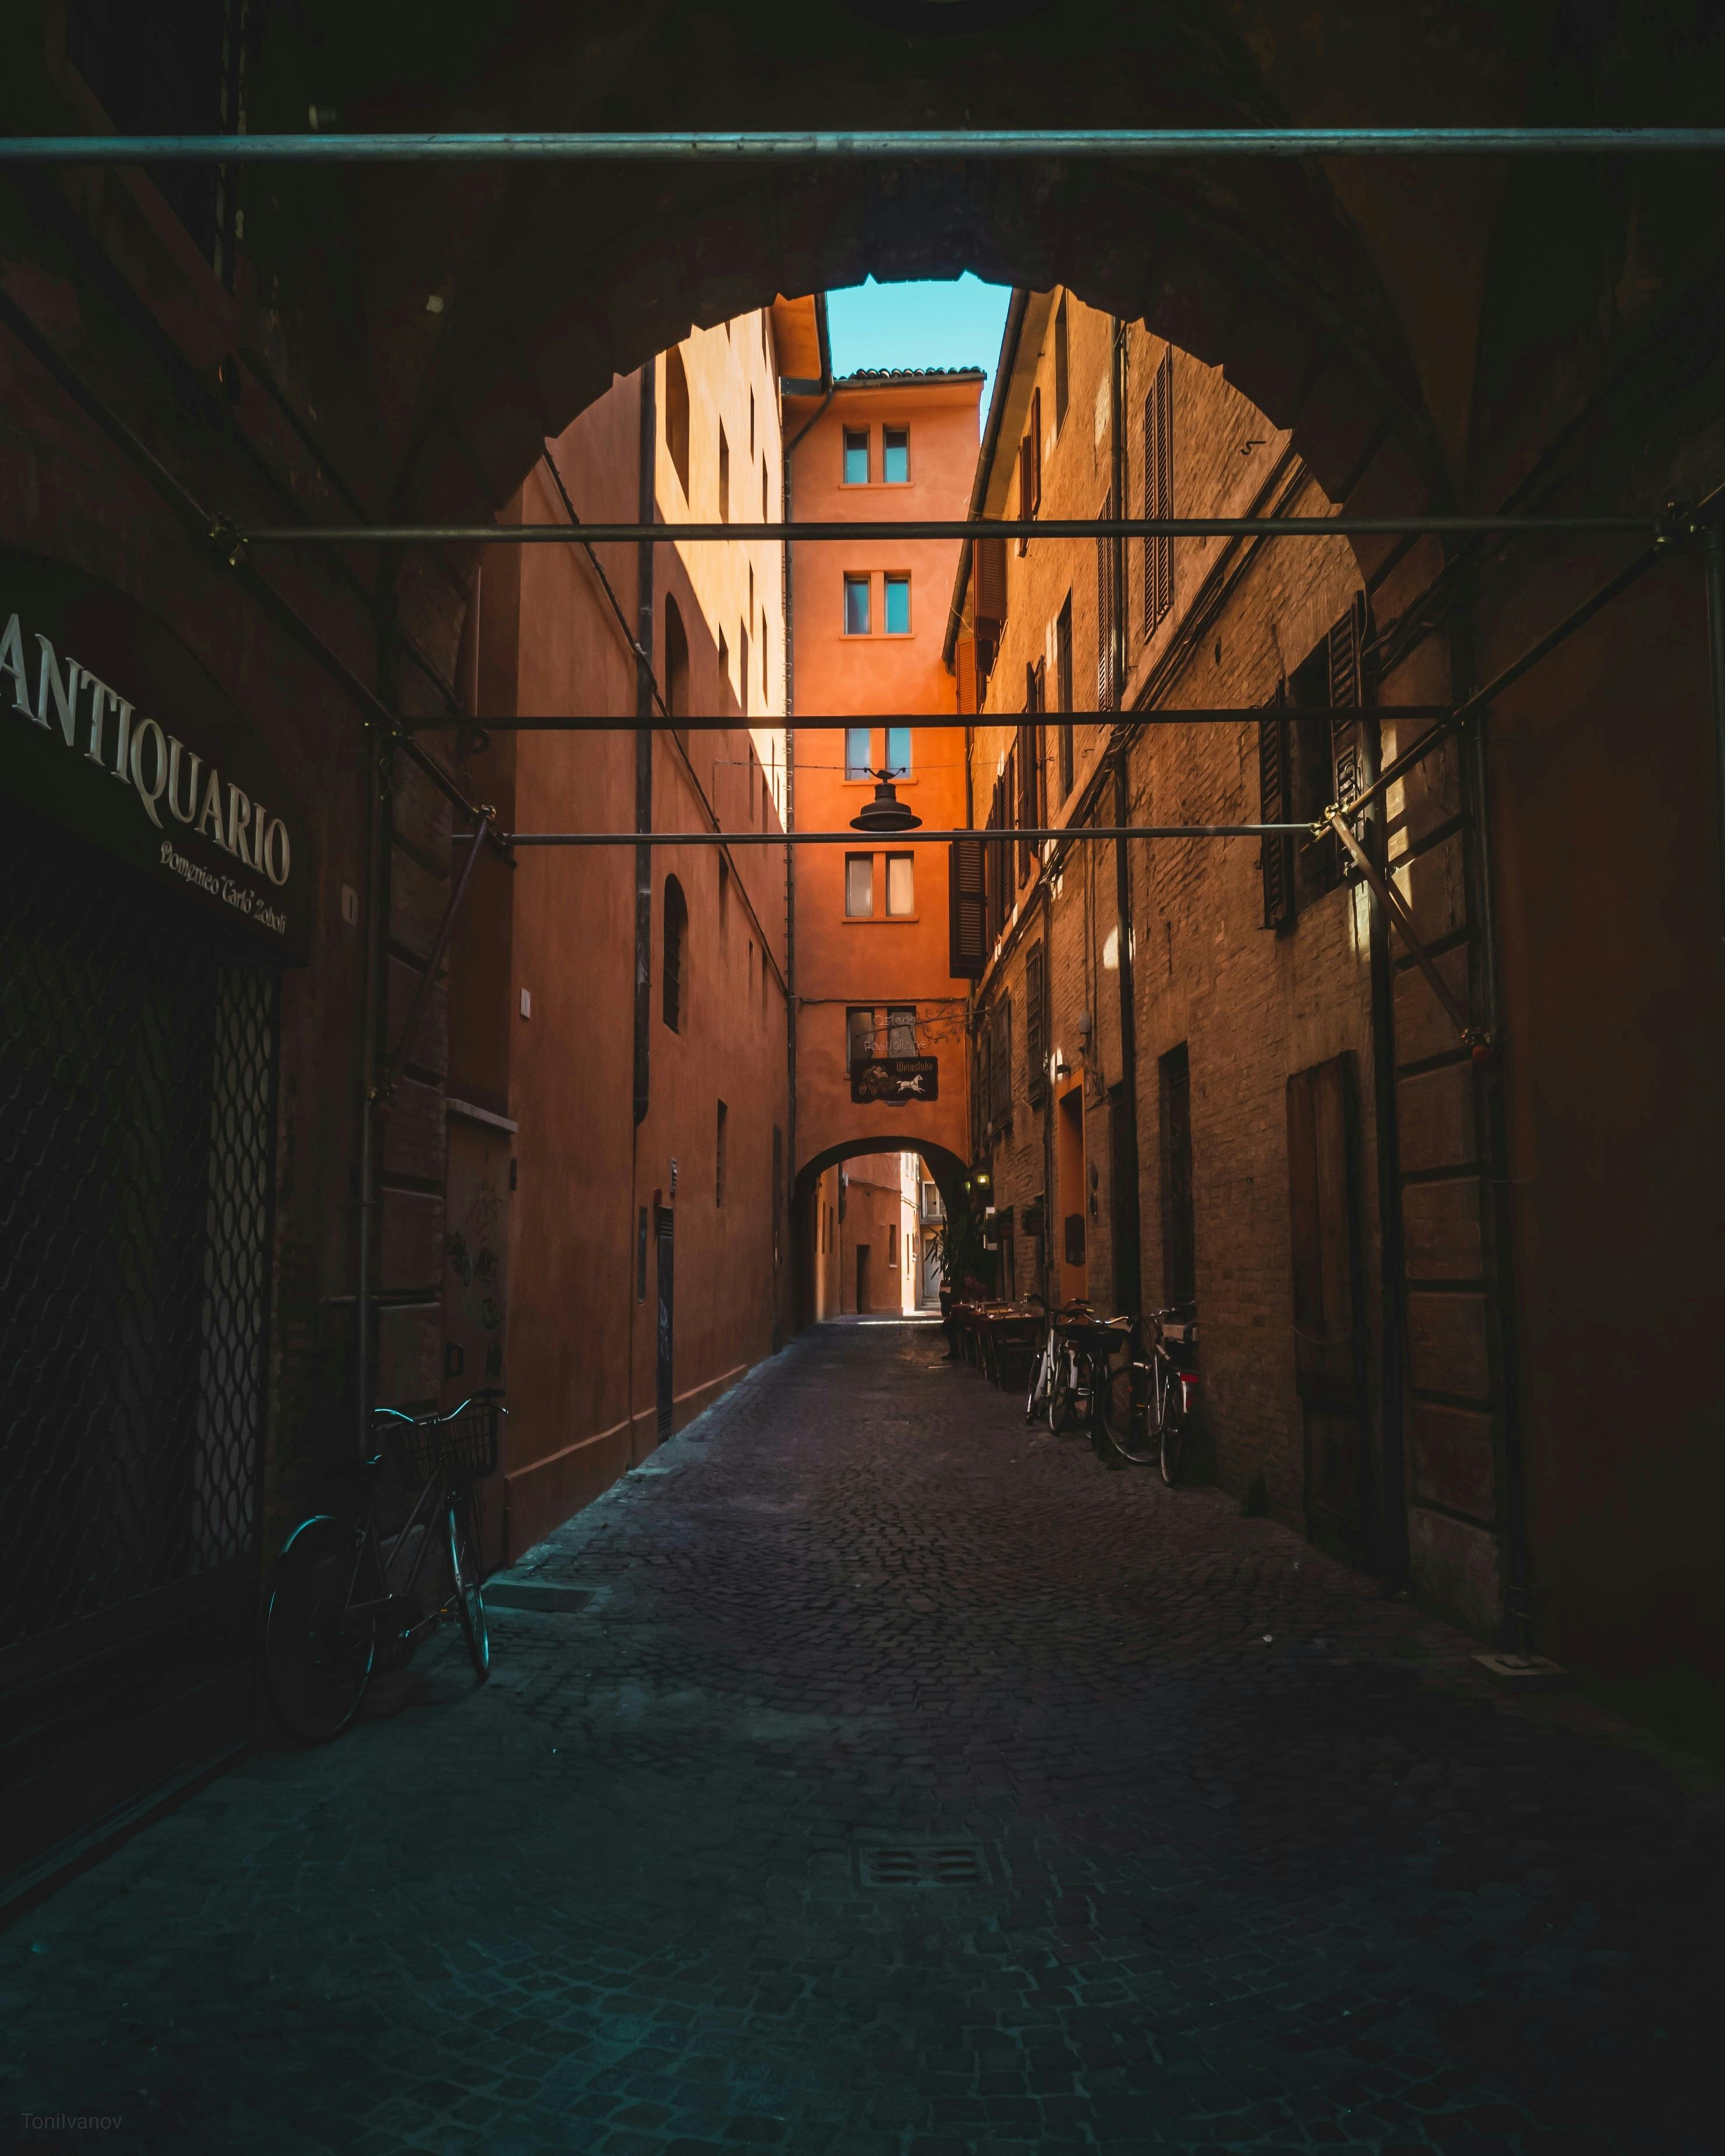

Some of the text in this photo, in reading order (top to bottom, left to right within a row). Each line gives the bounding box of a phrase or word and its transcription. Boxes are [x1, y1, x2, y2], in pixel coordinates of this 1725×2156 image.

[0, 614, 291, 886] ANTIQUARIO
[160, 840, 220, 894] Domenico
[253, 899, 287, 935] Zoboli
